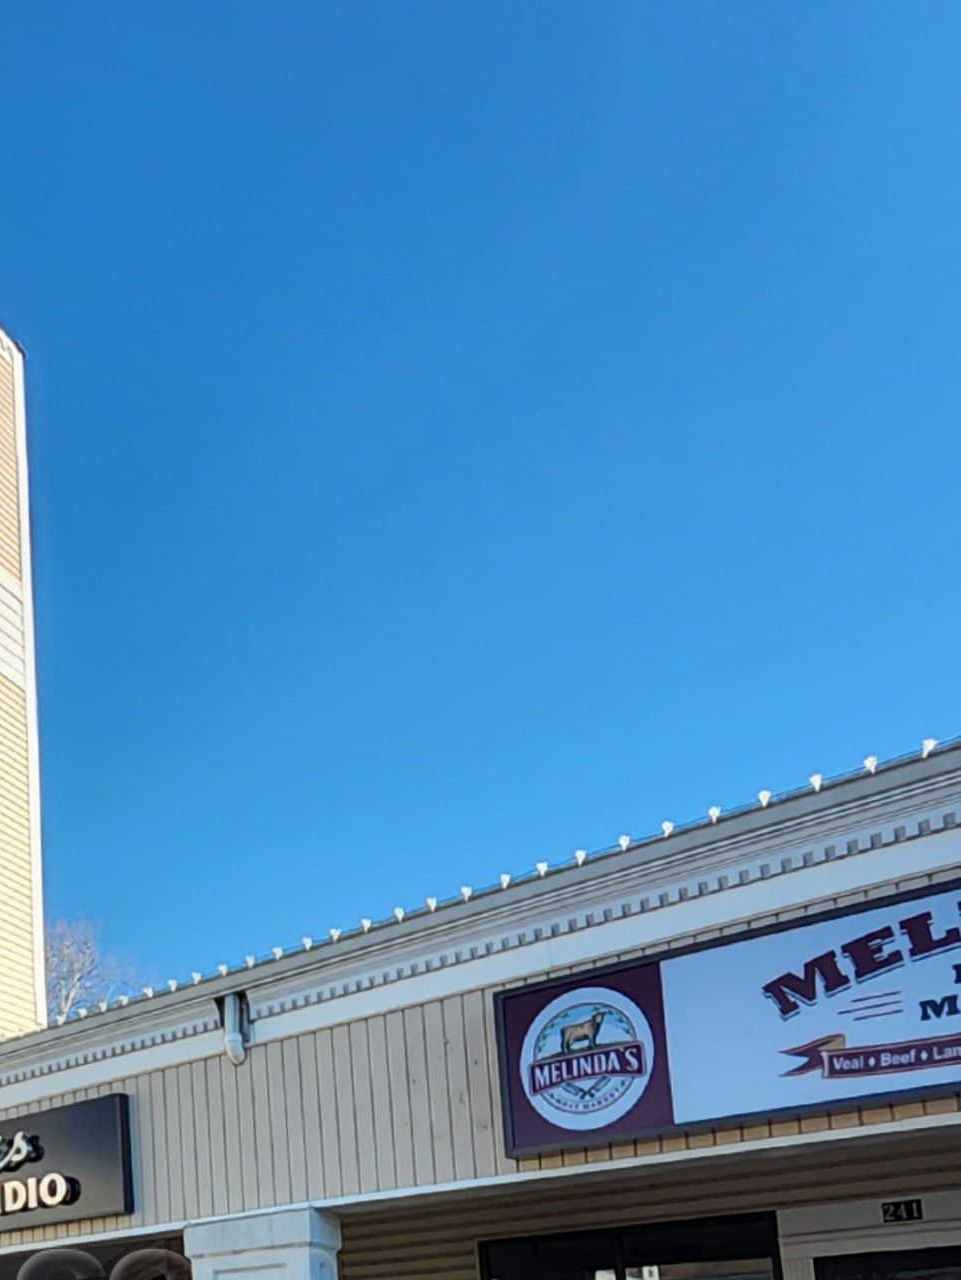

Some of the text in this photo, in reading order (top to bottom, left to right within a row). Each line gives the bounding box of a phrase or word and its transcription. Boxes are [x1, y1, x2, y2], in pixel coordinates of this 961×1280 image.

[762, 902, 961, 1020] MEL
[534, 1047, 639, 1089] MELINDA'S
[832, 1056, 864, 1071] Veal
[880, 1048, 917, 1066] Beef
[883, 1201, 919, 1220] 241
